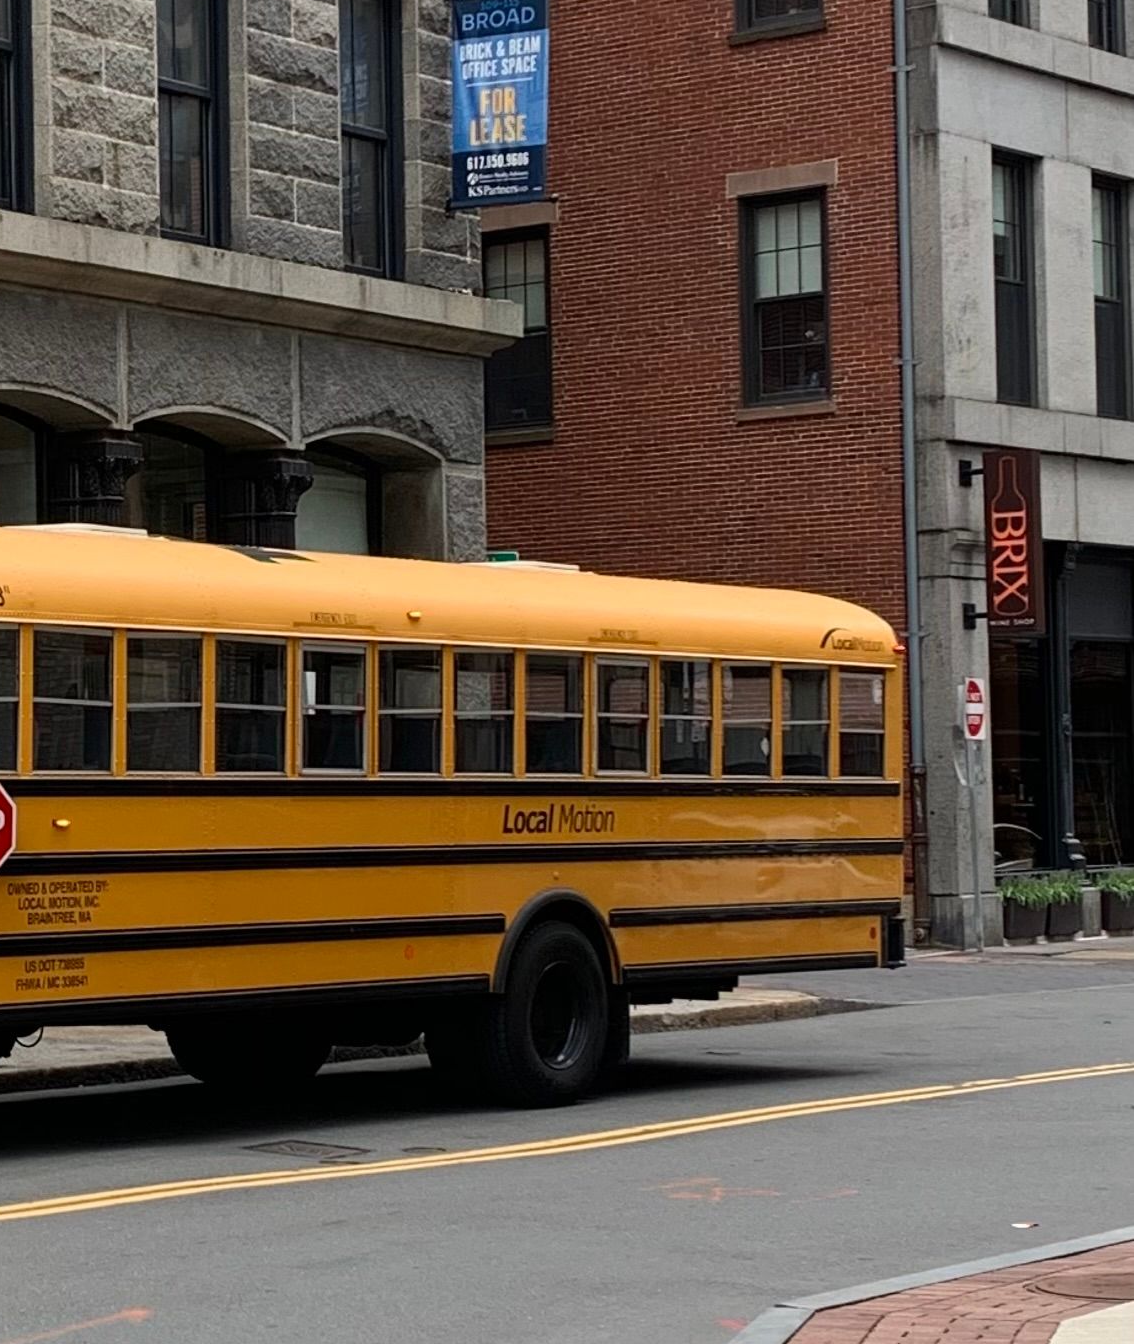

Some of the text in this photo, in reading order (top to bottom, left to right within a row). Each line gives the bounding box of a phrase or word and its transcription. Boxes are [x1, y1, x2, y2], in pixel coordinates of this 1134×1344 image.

[461, 6, 535, 32] BROAD
[459, 35, 541, 62] BRICK & BEAM
[462, 54, 538, 80] OFFICE SPACE
[479, 87, 516, 116] FOR
[469, 114, 527, 146] LEASE
[992, 511, 1028, 606] BRIX
[1013, 618, 1035, 626] SHOP
[502, 803, 615, 834] Local Motion
[7, 882, 40, 896] OWNED
[42, 882, 48, 895] &
[49, 880, 94, 894] OPERATED
[18, 897, 46, 911] LOCAL
[79, 911, 92, 923] MA
[24, 960, 37, 973] US
[38, 958, 56, 972] DOT
[16, 978, 41, 991] FHWA
[47, 976, 61, 989] MC
